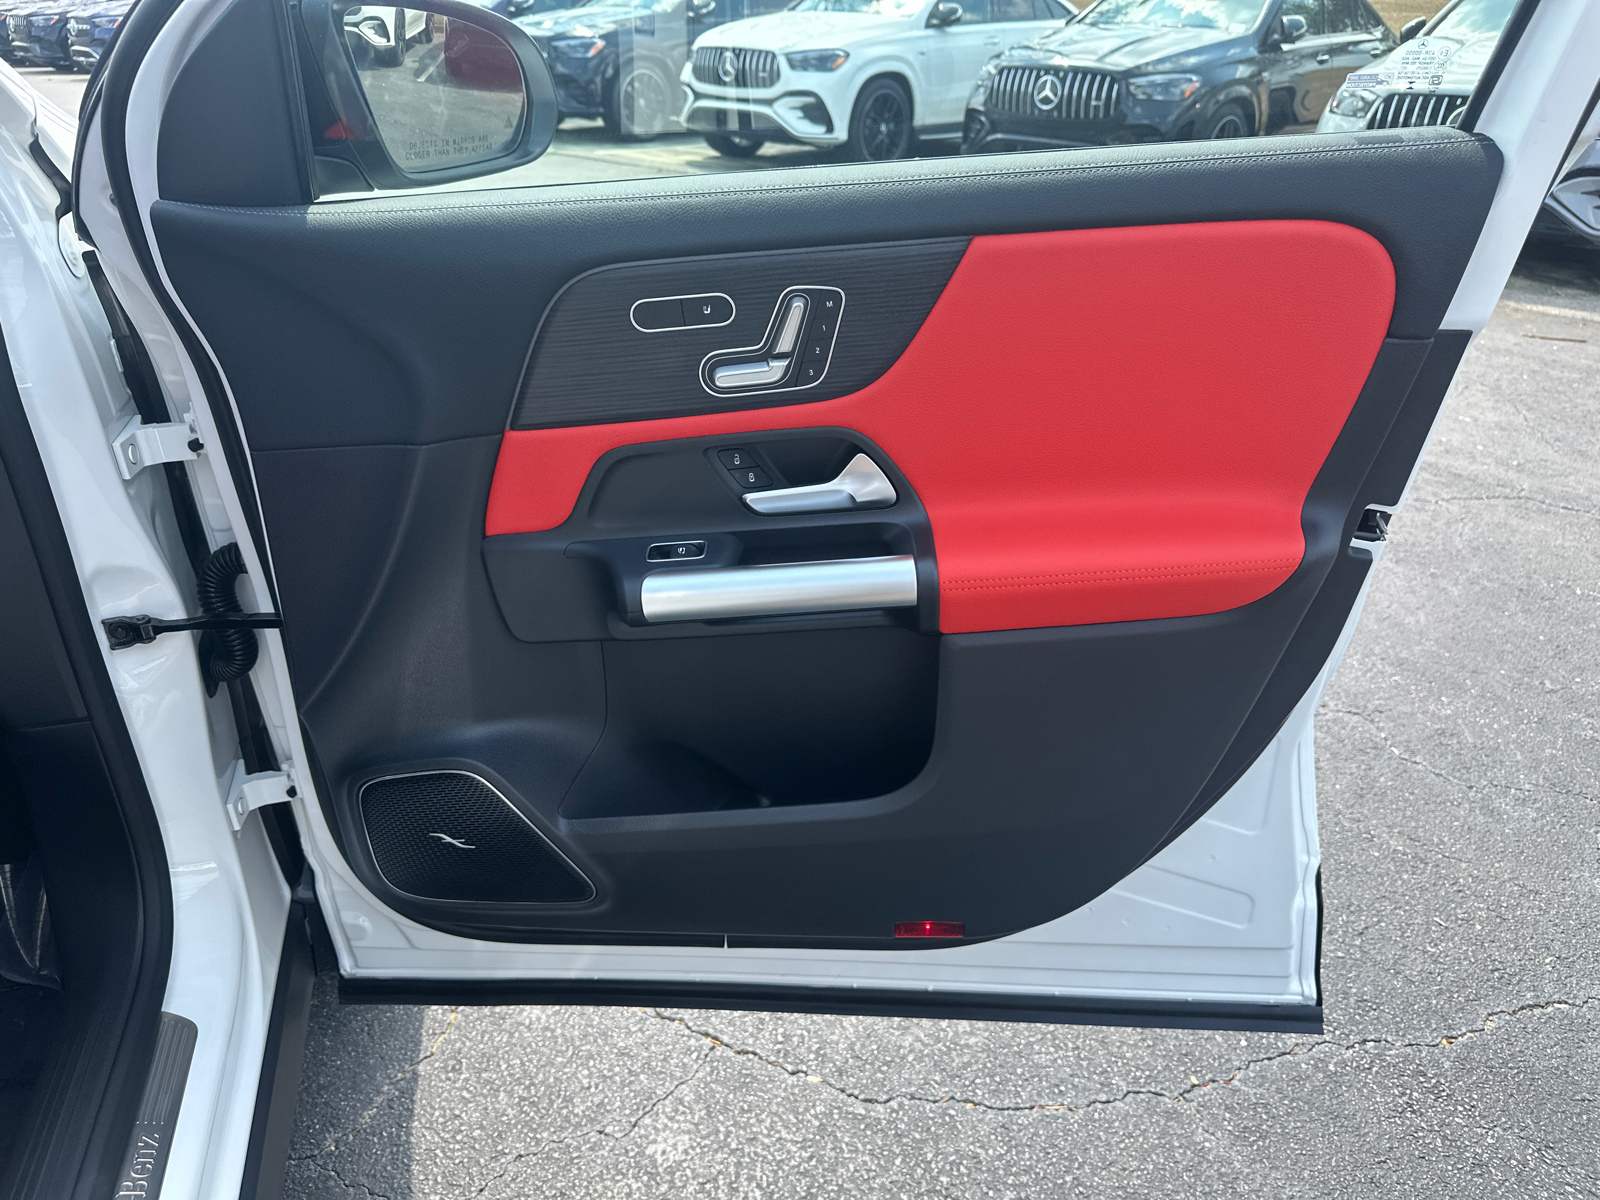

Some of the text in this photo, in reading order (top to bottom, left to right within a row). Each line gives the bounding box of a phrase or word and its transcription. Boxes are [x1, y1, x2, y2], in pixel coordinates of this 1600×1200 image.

[408, 134, 489, 150] OBJECTS IN MIRROR ARE
[405, 143, 494, 160] CLOSER THAN THEY APPEAR
[826, 300, 834, 308] M
